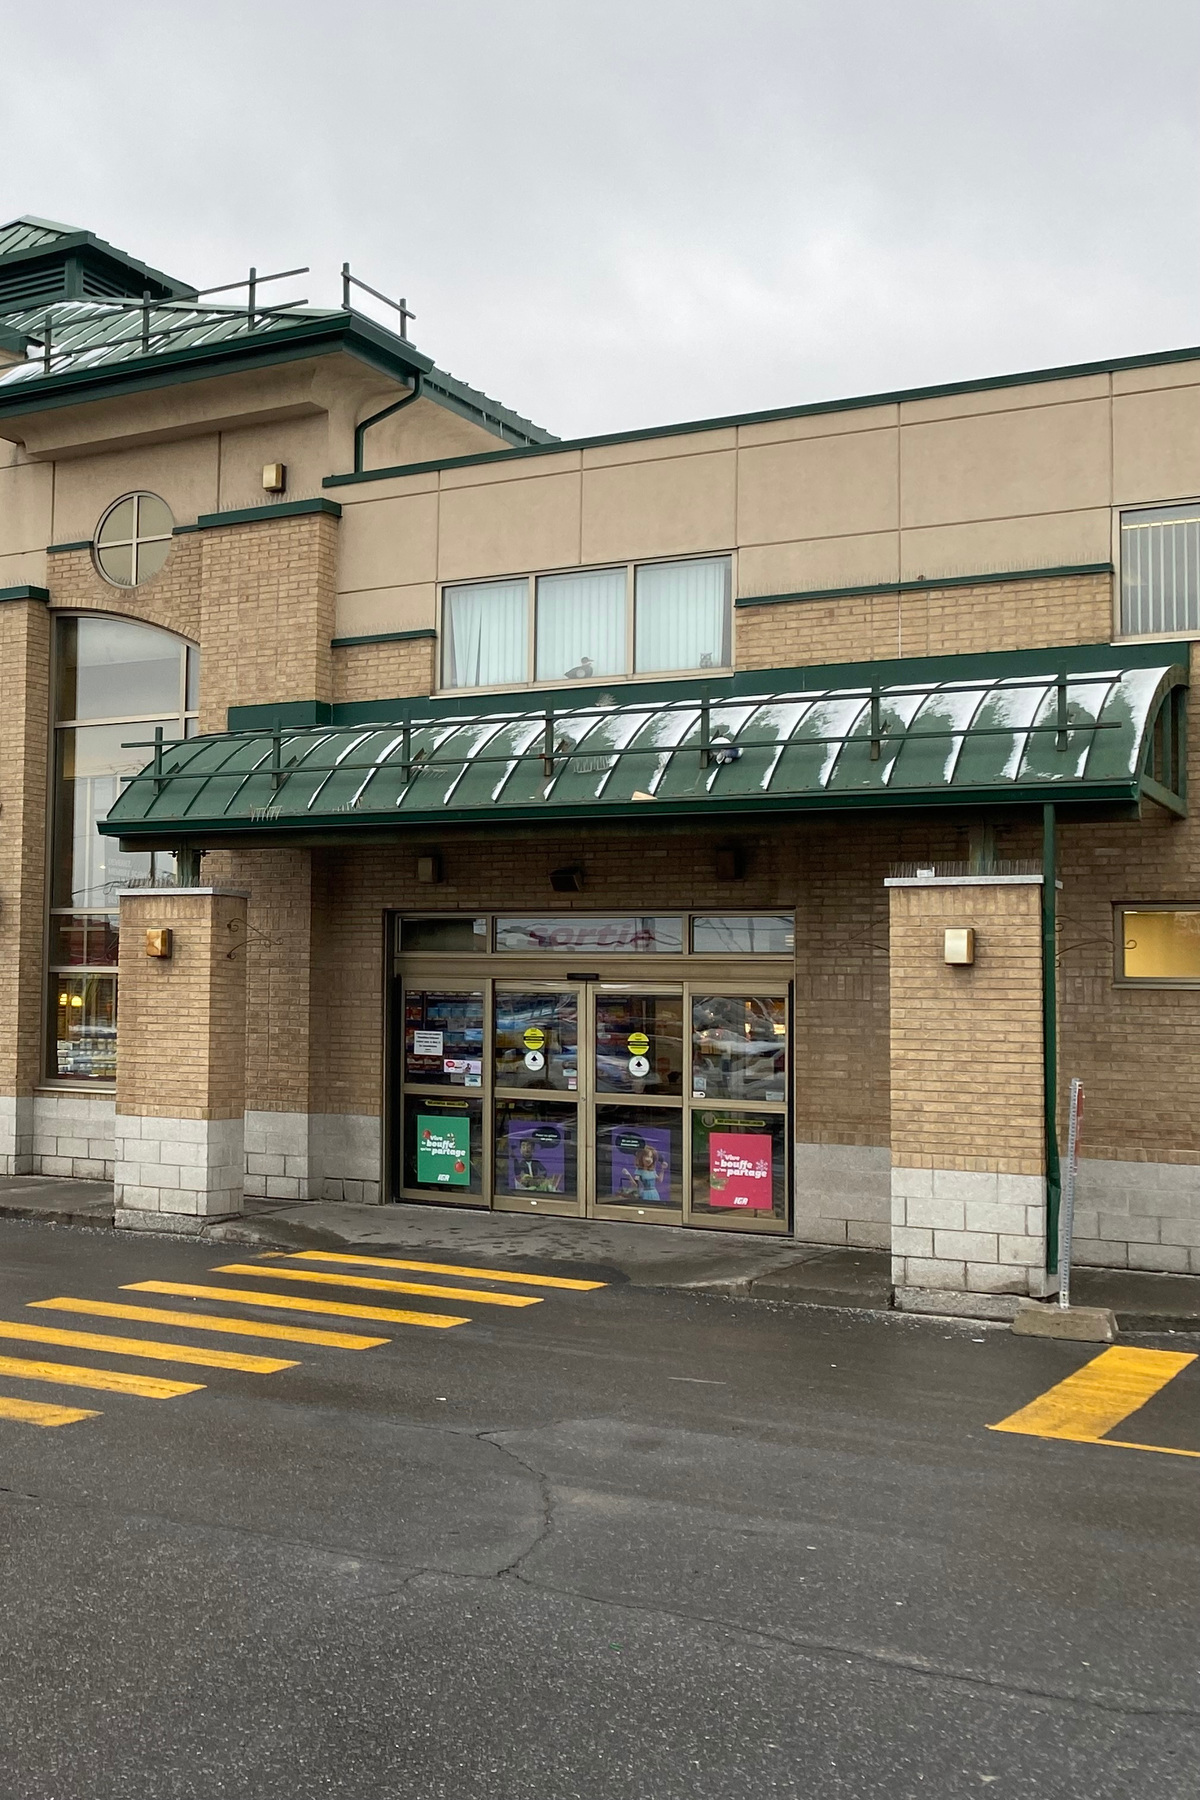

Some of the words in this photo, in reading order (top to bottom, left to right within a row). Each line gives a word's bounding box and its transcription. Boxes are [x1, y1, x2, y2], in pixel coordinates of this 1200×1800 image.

[527, 923, 656, 948] sortie
[432, 1148, 466, 1157] partage
[721, 1160, 753, 1169] bouffe
[727, 1168, 767, 1178] partage
[733, 1197, 749, 1205] IGA
